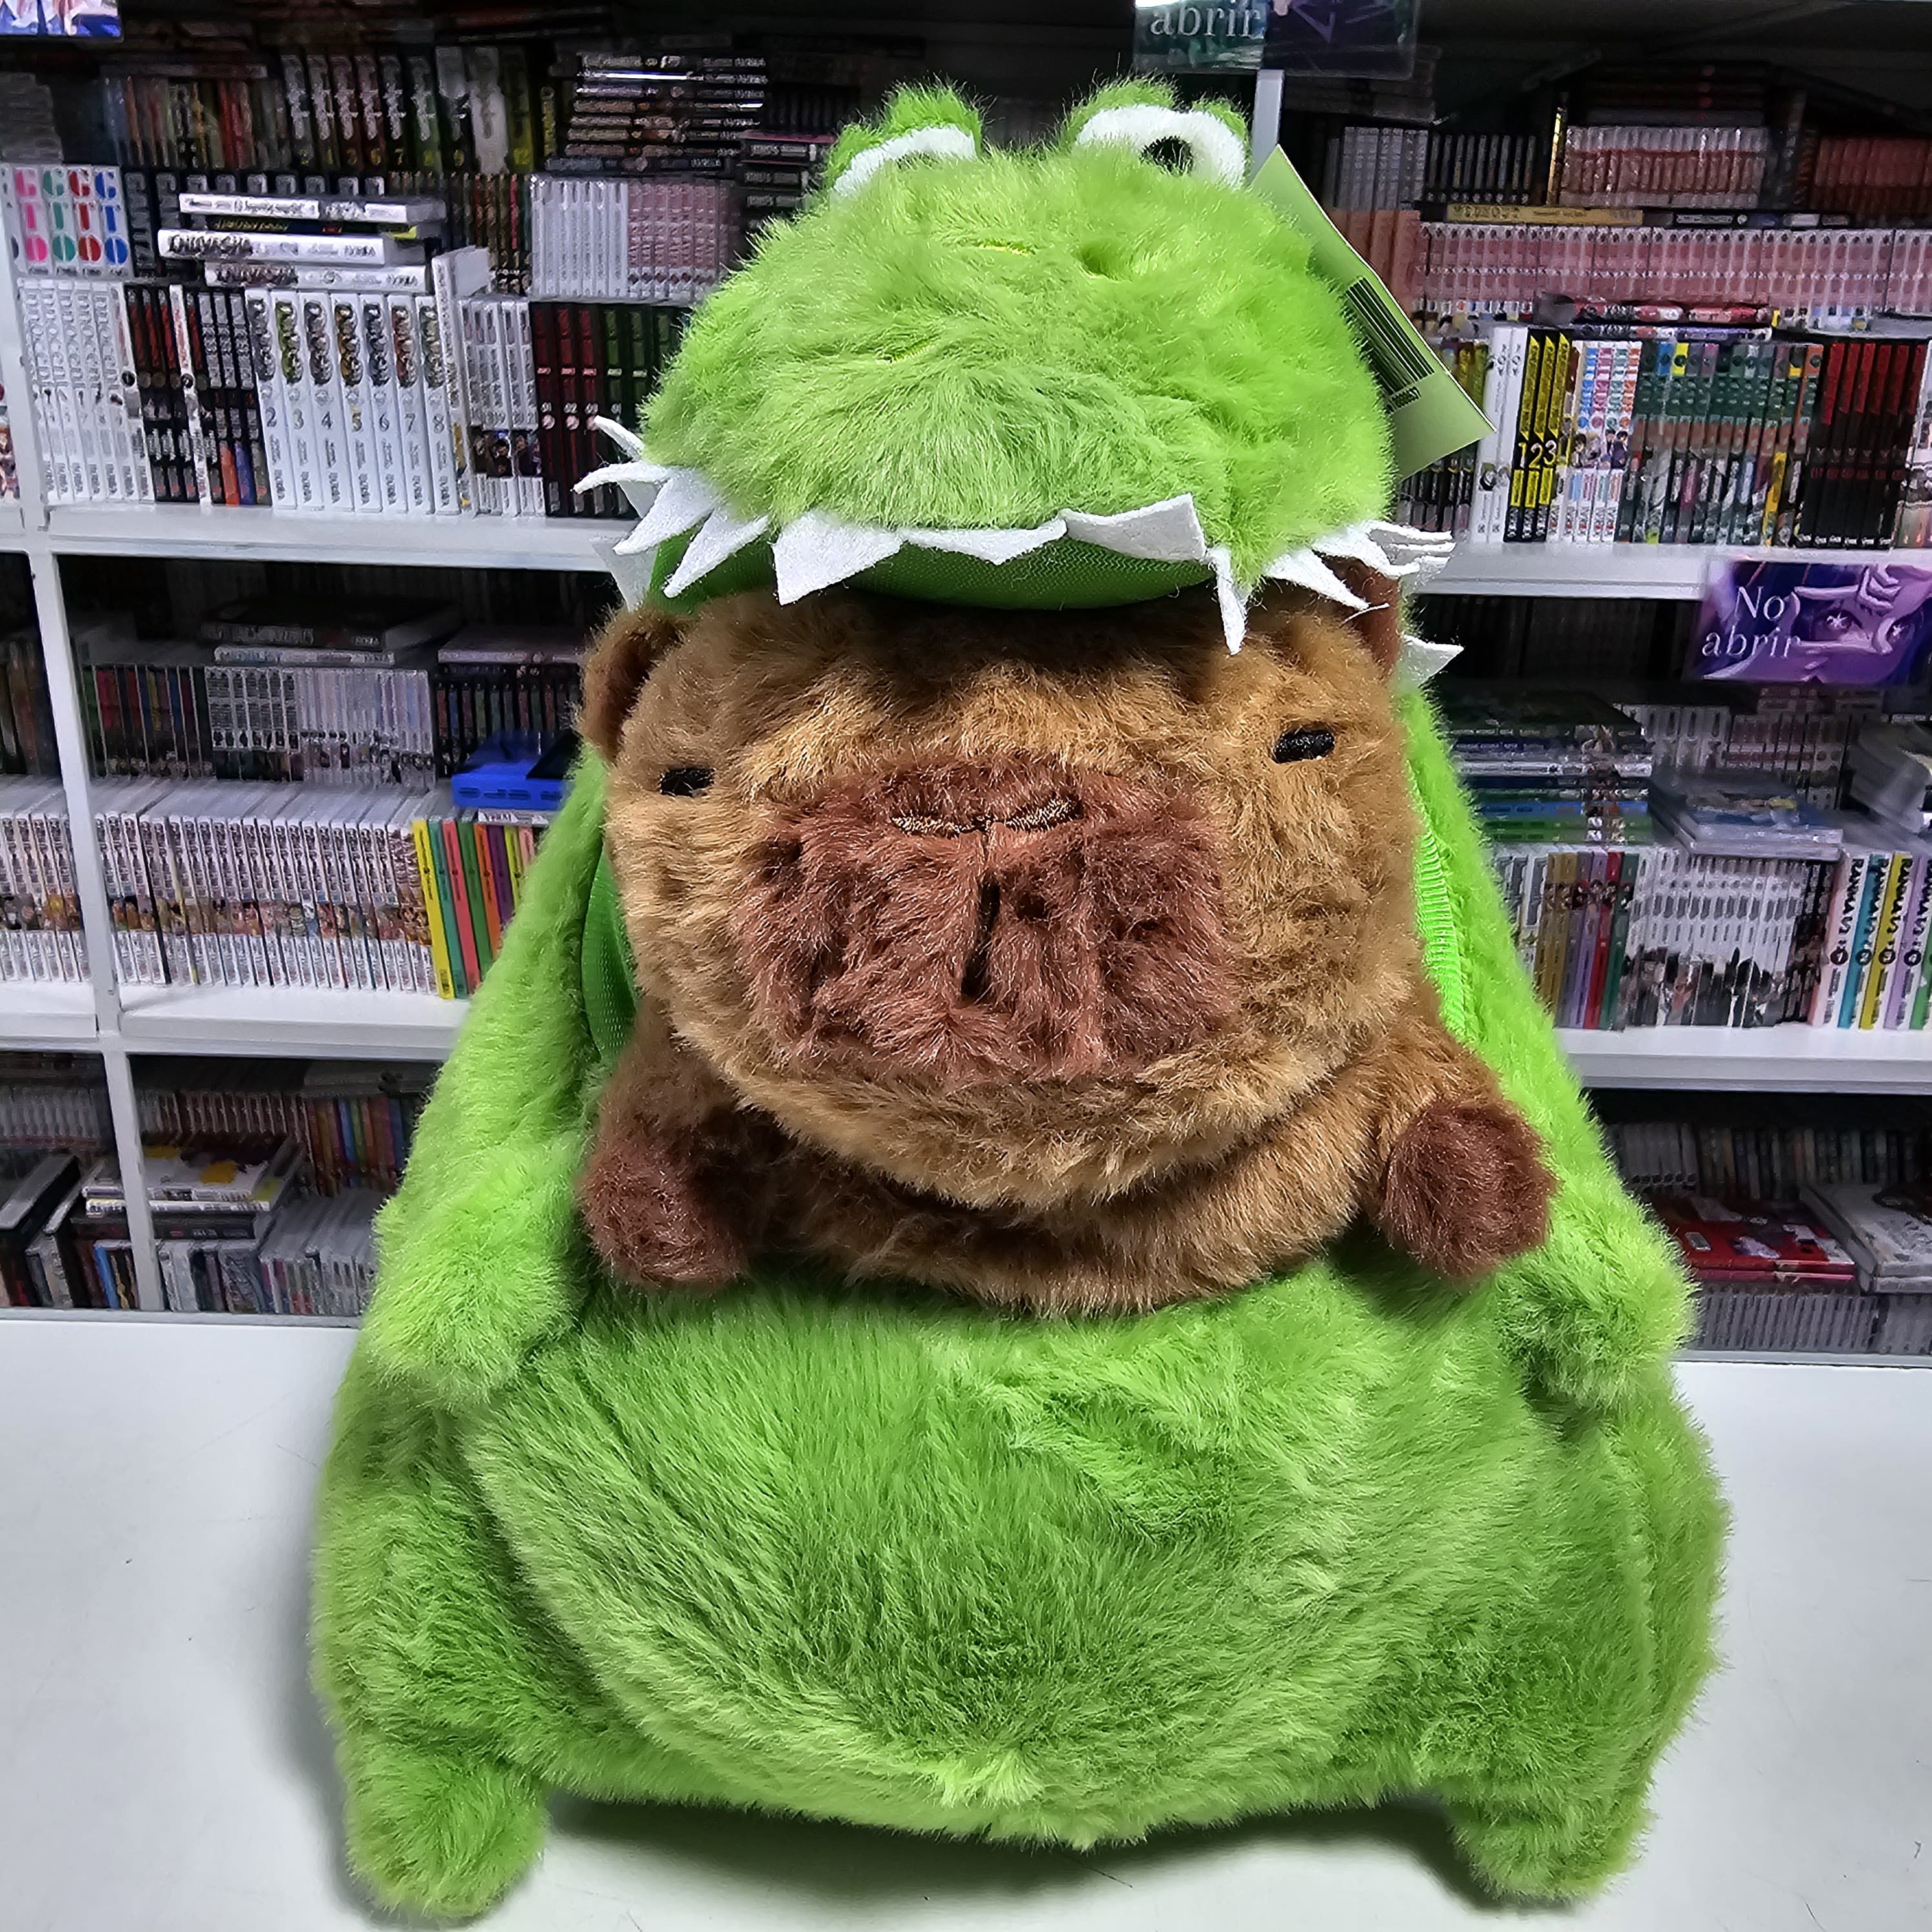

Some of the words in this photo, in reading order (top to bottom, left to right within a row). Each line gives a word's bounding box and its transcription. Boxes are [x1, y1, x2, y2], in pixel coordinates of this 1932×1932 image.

[1150, 0, 1261, 37] abrir
[265, 407, 277, 427] 2
[293, 408, 304, 429] 3
[322, 411, 334, 429] 4
[351, 412, 362, 432] 5
[379, 413, 390, 431] 6
[404, 413, 416, 434] 7
[433, 413, 444, 434] 8
[1518, 442, 1527, 468] 1
[1528, 442, 1543, 469] 2
[1543, 440, 1557, 466] 3
[1734, 586, 1786, 622] No
[1701, 625, 1802, 659] abrir
